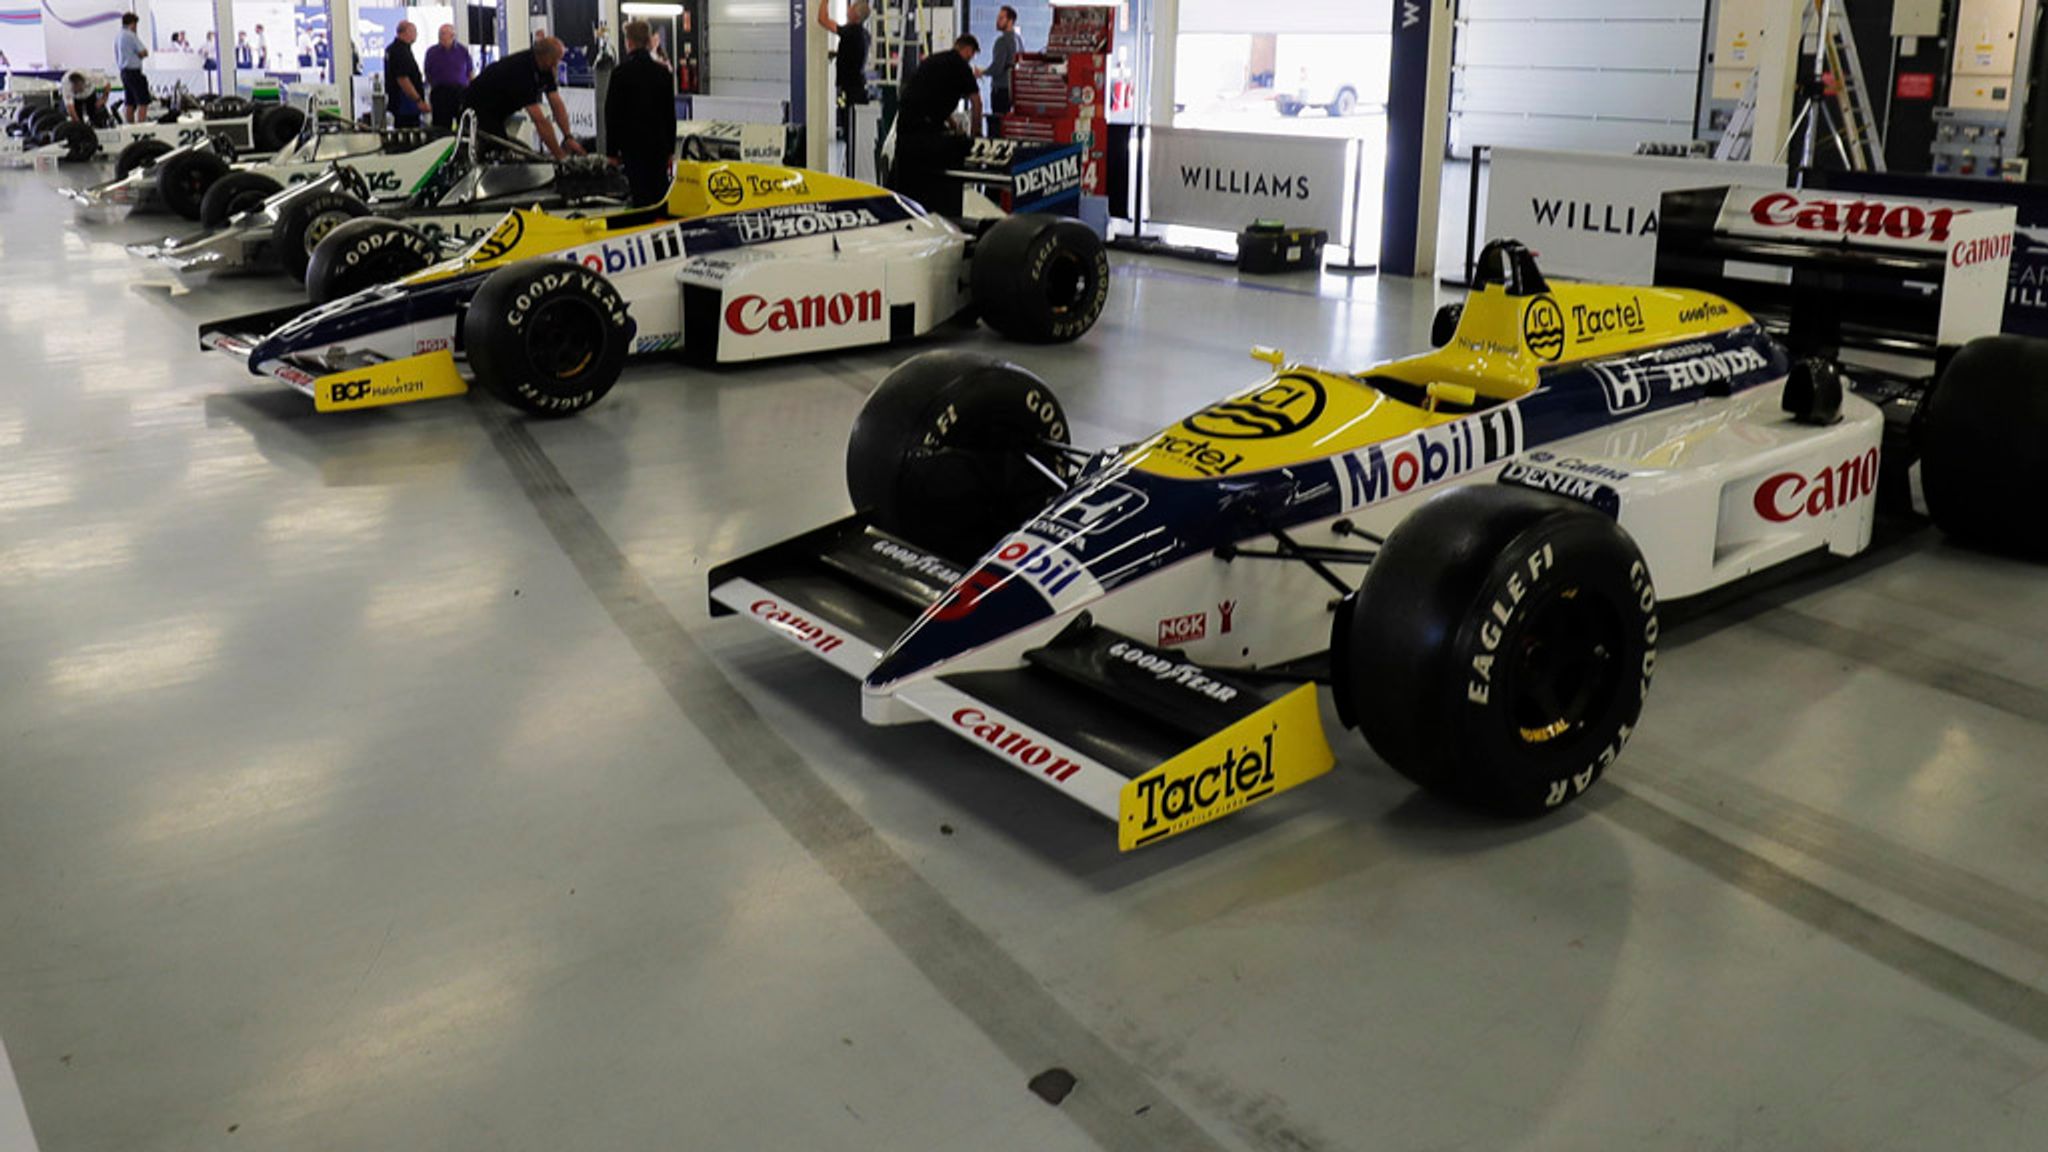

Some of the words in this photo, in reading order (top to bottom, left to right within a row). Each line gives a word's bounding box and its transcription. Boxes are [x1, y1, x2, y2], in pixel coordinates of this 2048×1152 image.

[365, 171, 401, 193] TAG
[1016, 155, 1080, 196] DENIM
[1181, 165, 1310, 200] WILLIAMS
[772, 208, 880, 239] HONDA
[1952, 232, 2012, 269] Canon
[725, 288, 882, 336] Canon
[1532, 307, 1554, 328] ICI
[1572, 296, 1644, 337] Tactel
[1666, 346, 1768, 392] HONDA
[332, 380, 371, 402] BCF
[1249, 386, 1307, 409] CI
[1026, 389, 1065, 442] GOO
[1342, 419, 1473, 508] Mobil
[1504, 462, 1601, 501] DENIM
[998, 542, 1082, 597] obil
[750, 599, 844, 654] Canon
[1160, 614, 1205, 640] NGK
[1468, 571, 1527, 705] EAGLE
[1108, 641, 1238, 703] GOODYEAR
[952, 707, 1082, 784] Canon
[1137, 730, 1277, 833] Tactel
